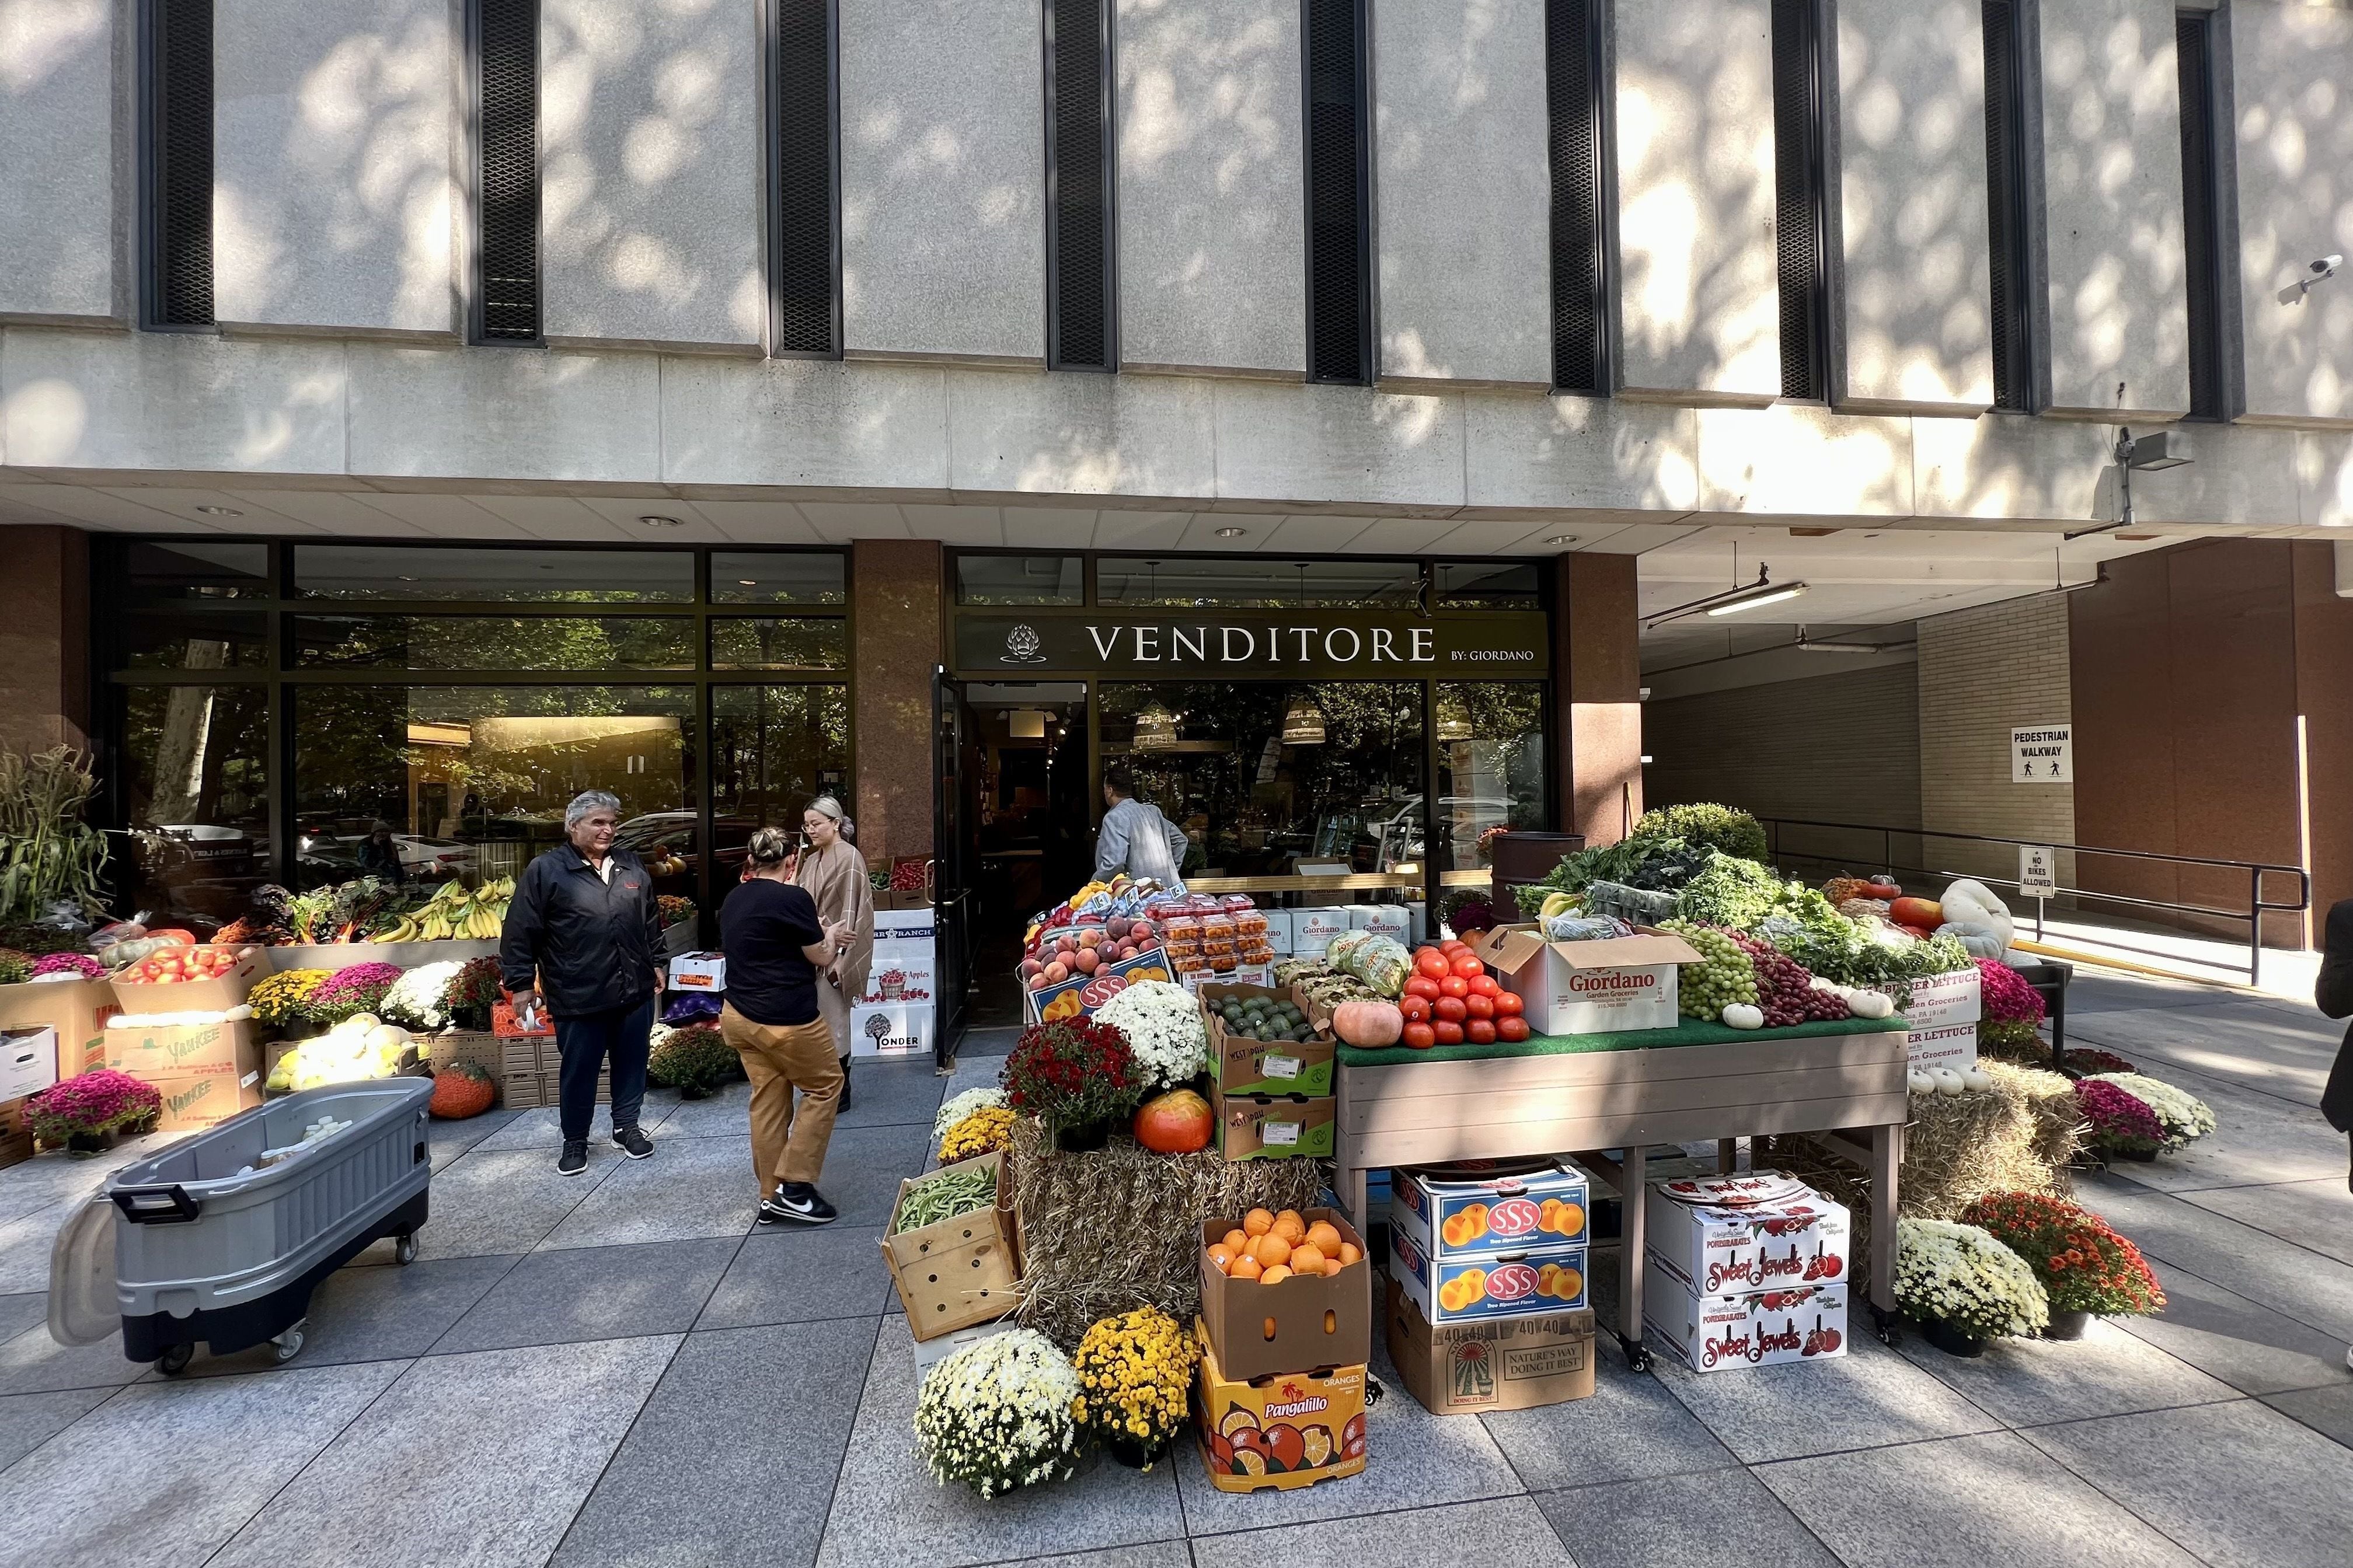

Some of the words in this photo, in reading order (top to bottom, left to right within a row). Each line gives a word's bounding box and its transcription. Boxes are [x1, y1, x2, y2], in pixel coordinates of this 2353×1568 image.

[1085, 626, 1435, 662] VENDITORE
[1451, 650, 1467, 661] BY:
[1469, 650, 1534, 661] GIORDANO
[2014, 731, 2068, 743] PEDESTRIAN
[2021, 746, 2062, 757] WALKWAY
[2028, 867, 2046, 876] BIKES
[2023, 878, 2051, 887] ALLOWED
[1303, 925, 1340, 934] Giordano
[1363, 924, 1400, 932] Giordano
[908, 970, 929, 980] Apples
[1570, 972, 1655, 991] Giordano
[1933, 972, 1979, 987] LETTUCE
[1928, 996, 1968, 1007] Groceries
[1929, 1008, 1947, 1017] 19148
[1925, 1026, 1974, 1040] LETTUCE
[166, 1027, 220, 1064] YANKEE
[873, 1032, 919, 1050] YONDER
[1229, 1049, 1246, 1060] WEST
[1922, 1048, 1963, 1059] Groceries
[1924, 1061, 1942, 1070] 19148
[167, 1080, 211, 1120] YANKEE
[1229, 1116, 1247, 1128] WEST
[1494, 1203, 1534, 1231] SSS
[1707, 1237, 1751, 1249] POMEGRANATES
[1706, 1258, 1752, 1292] Sweet
[1748, 1250, 1803, 1287] Jewels
[1493, 1268, 1532, 1295] SSS
[1703, 1311, 1747, 1324] POMEGRANATES
[1702, 1333, 1751, 1368] Sweet
[1748, 1325, 1801, 1363] Jewels
[1509, 1349, 1556, 1364] NATURE'S
[1556, 1347, 1577, 1357] WAY
[1511, 1362, 1544, 1374] DOING
[1546, 1361, 1554, 1370] IT
[1323, 1374, 1360, 1387] ORANGES
[1264, 1396, 1328, 1419] Pangalillo
[1326, 1459, 1361, 1474] ORANGES
